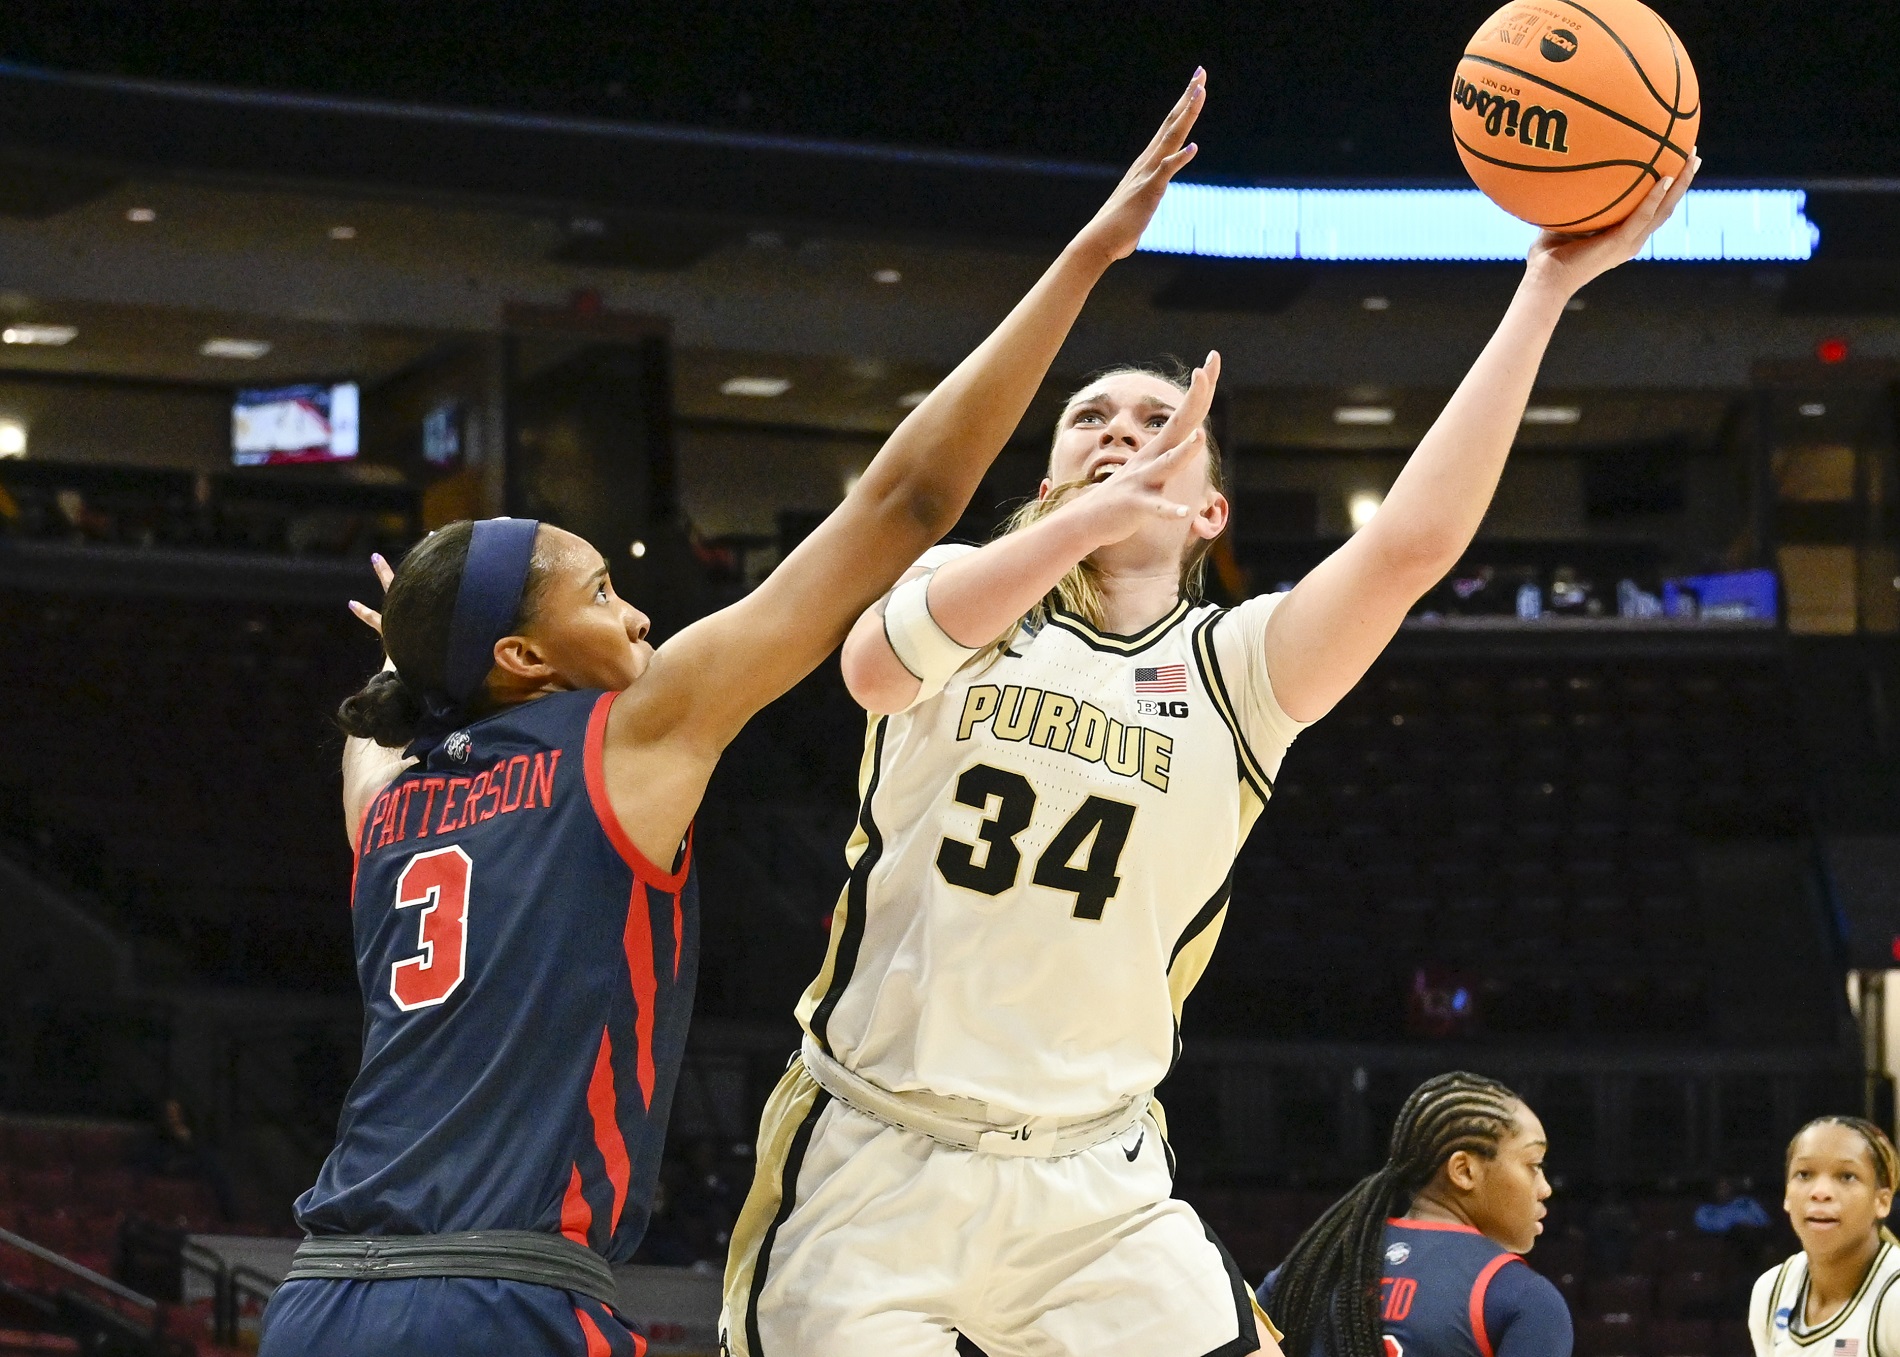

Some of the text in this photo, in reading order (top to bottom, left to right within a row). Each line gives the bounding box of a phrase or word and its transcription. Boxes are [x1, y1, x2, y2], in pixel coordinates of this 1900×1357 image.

[1453, 73, 1570, 154] Wilson
[1480, 77, 1521, 96] EVO NXT
[956, 684, 1174, 793] PURDUE
[364, 749, 562, 856] PATTERSON
[933, 762, 1140, 925] 34
[390, 844, 473, 1012] 3
